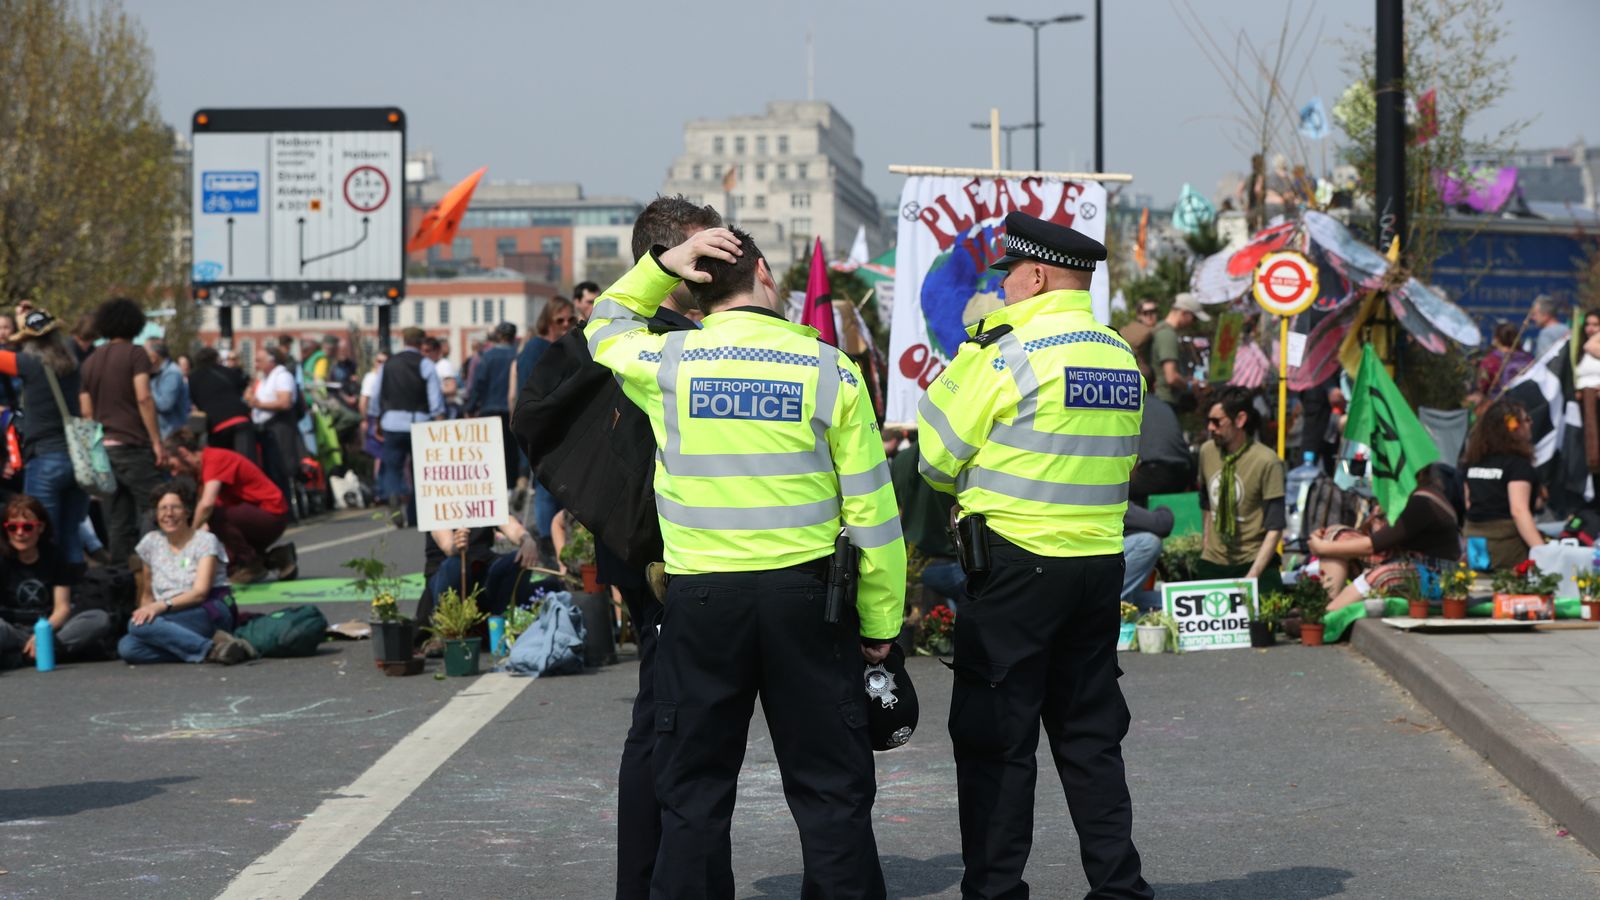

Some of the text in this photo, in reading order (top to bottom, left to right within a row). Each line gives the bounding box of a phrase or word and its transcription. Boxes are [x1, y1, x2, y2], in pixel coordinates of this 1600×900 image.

[919, 176, 1085, 252] PLEASE
[898, 343, 947, 391] OU
[1068, 371, 1138, 384] METROPOLITAN
[692, 380, 801, 395] METROPOLITAN
[1069, 383, 1138, 406] POLICE
[692, 393, 800, 418] POLICE
[428, 424, 490, 443] WE WILL
[425, 446, 483, 462] BE LESS
[424, 464, 490, 481] REBELLIOUS
[422, 481, 493, 497] IF YOU WILL BE
[434, 499, 497, 521] LESS SHIT
[1175, 592, 1244, 617] STOP
[1177, 618, 1249, 633] ECOCIDE
